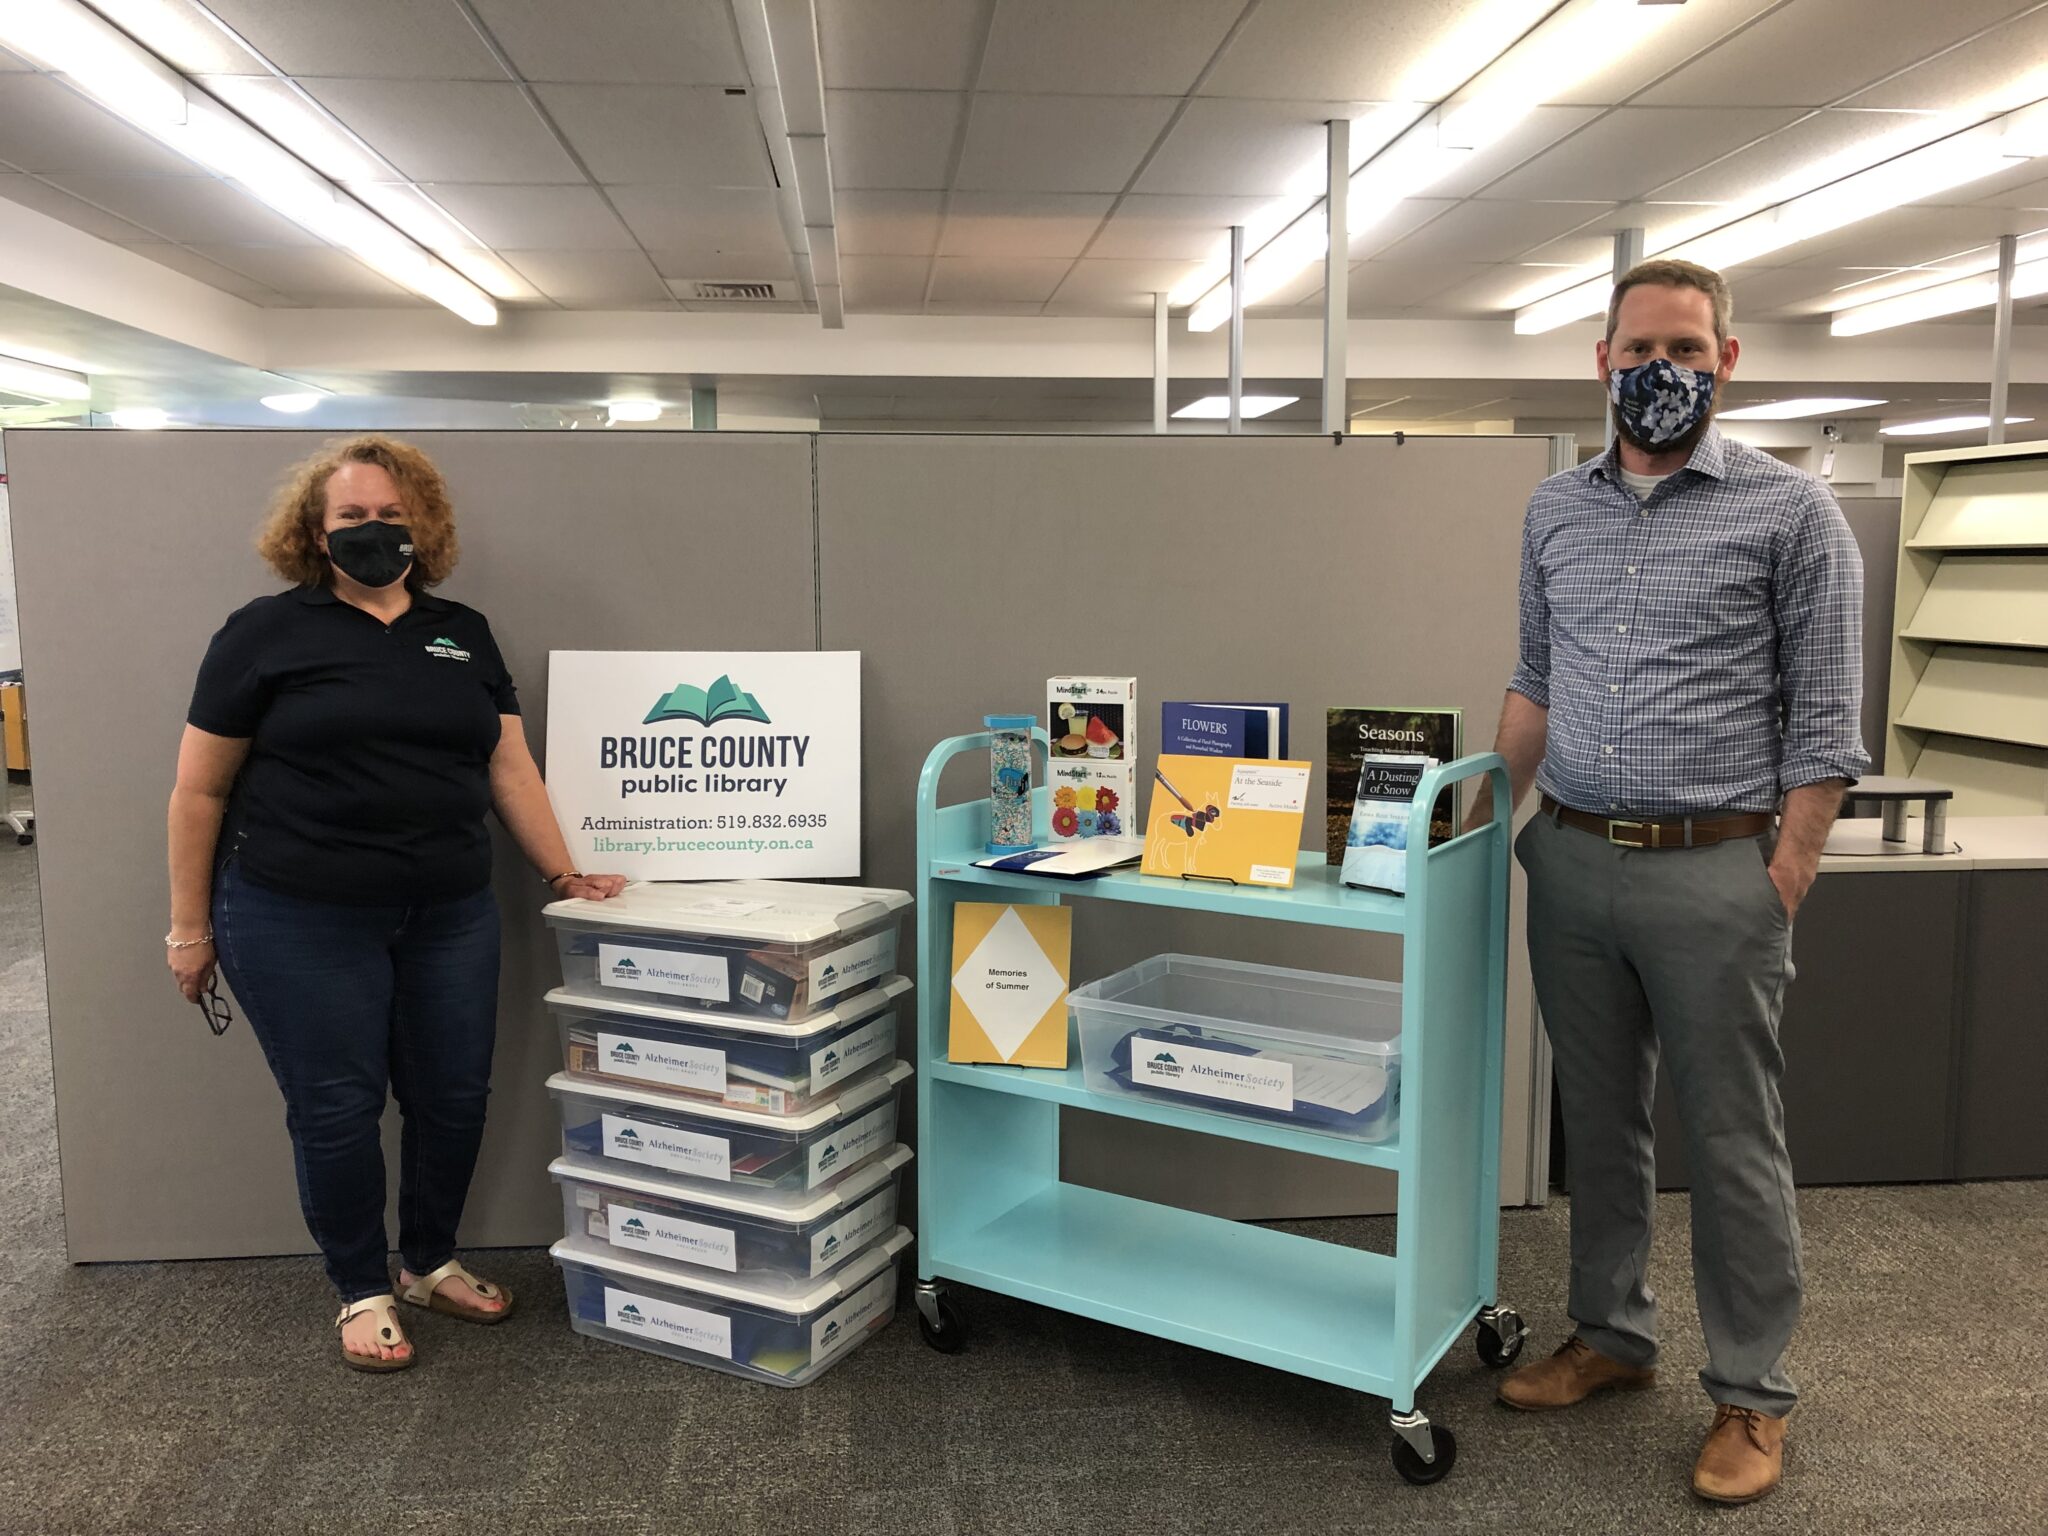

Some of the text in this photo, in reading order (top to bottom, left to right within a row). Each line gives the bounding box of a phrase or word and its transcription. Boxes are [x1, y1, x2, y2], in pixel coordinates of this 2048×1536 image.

[1182, 718, 1228, 734] FLOWERS
[1359, 724, 1424, 742] Seasons
[600, 735, 811, 769] BRUCE COUNTY
[1360, 746, 1383, 754] Touching
[621, 773, 788, 799] public library
[1235, 777, 1283, 787] At the Seaside
[1367, 770, 1419, 786] A Dusting
[1369, 783, 1411, 795] of Snow
[580, 814, 828, 832] Administration: 519.832.6935
[593, 836, 815, 855] library.brucecounty.on.ca
[842, 957, 873, 974] Alzheimer
[989, 969, 1027, 977] Memories
[646, 968, 720, 988] Alzheimer Society
[996, 982, 1029, 990] Summer
[843, 1038, 874, 1059] Alzheimer
[645, 1053, 720, 1076] Alzheimer Society
[1147, 1061, 1184, 1074] BRUCE COUNTY
[1190, 1064, 1285, 1091] Alzheimer Society
[649, 1140, 692, 1155] Alzheimer
[692, 1148, 723, 1164] Society
[655, 1229, 698, 1245] Alzheimer
[698, 1239, 729, 1255] Society
[650, 1317, 693, 1333] Alzheimer
[694, 1327, 724, 1344] Society
